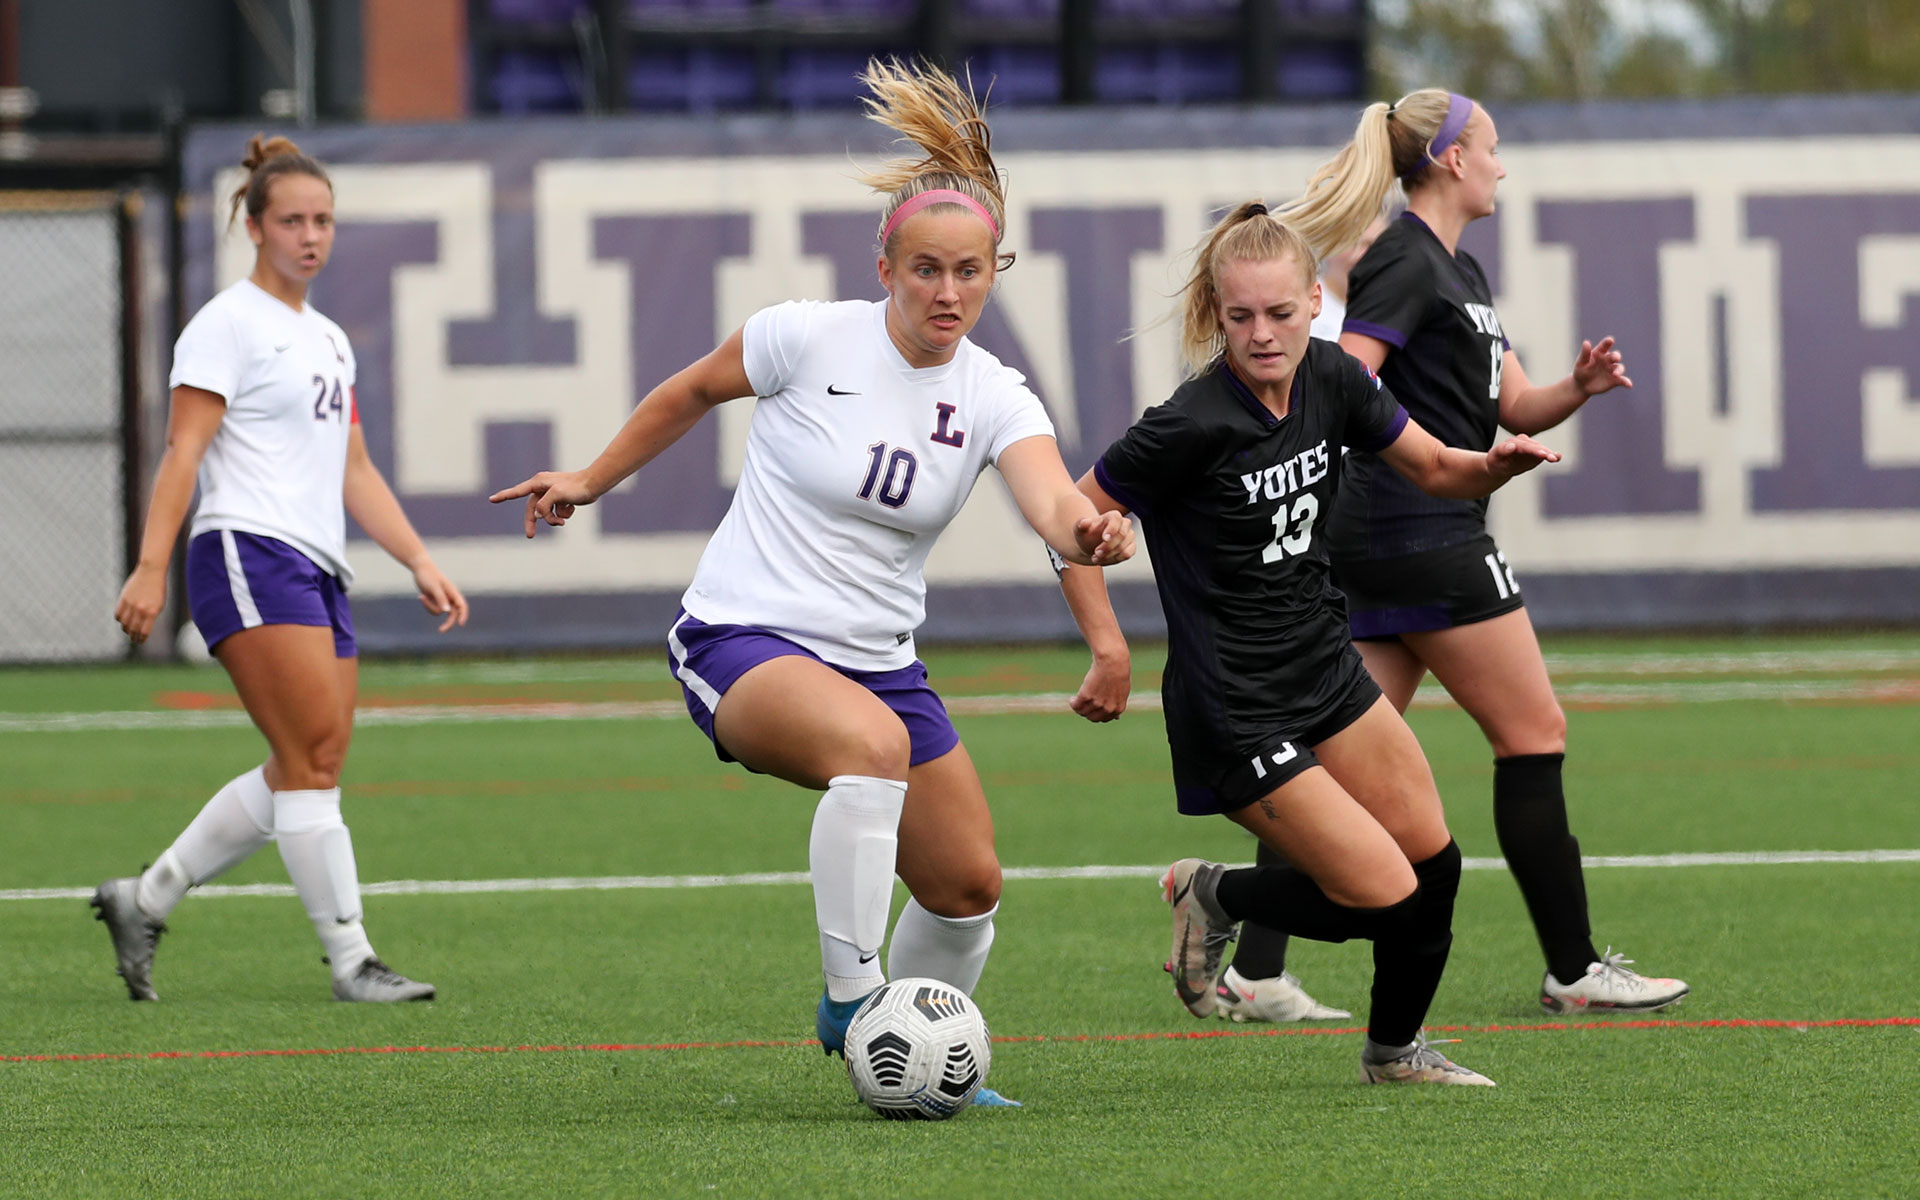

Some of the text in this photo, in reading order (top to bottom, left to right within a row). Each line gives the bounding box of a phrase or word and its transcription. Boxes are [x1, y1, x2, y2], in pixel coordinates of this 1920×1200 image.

[312, 374, 343, 423] 24
[930, 401, 965, 448] L
[856, 440, 920, 509] 10
[1240, 439, 1329, 505] YOTES
[1262, 493, 1319, 564] 13
